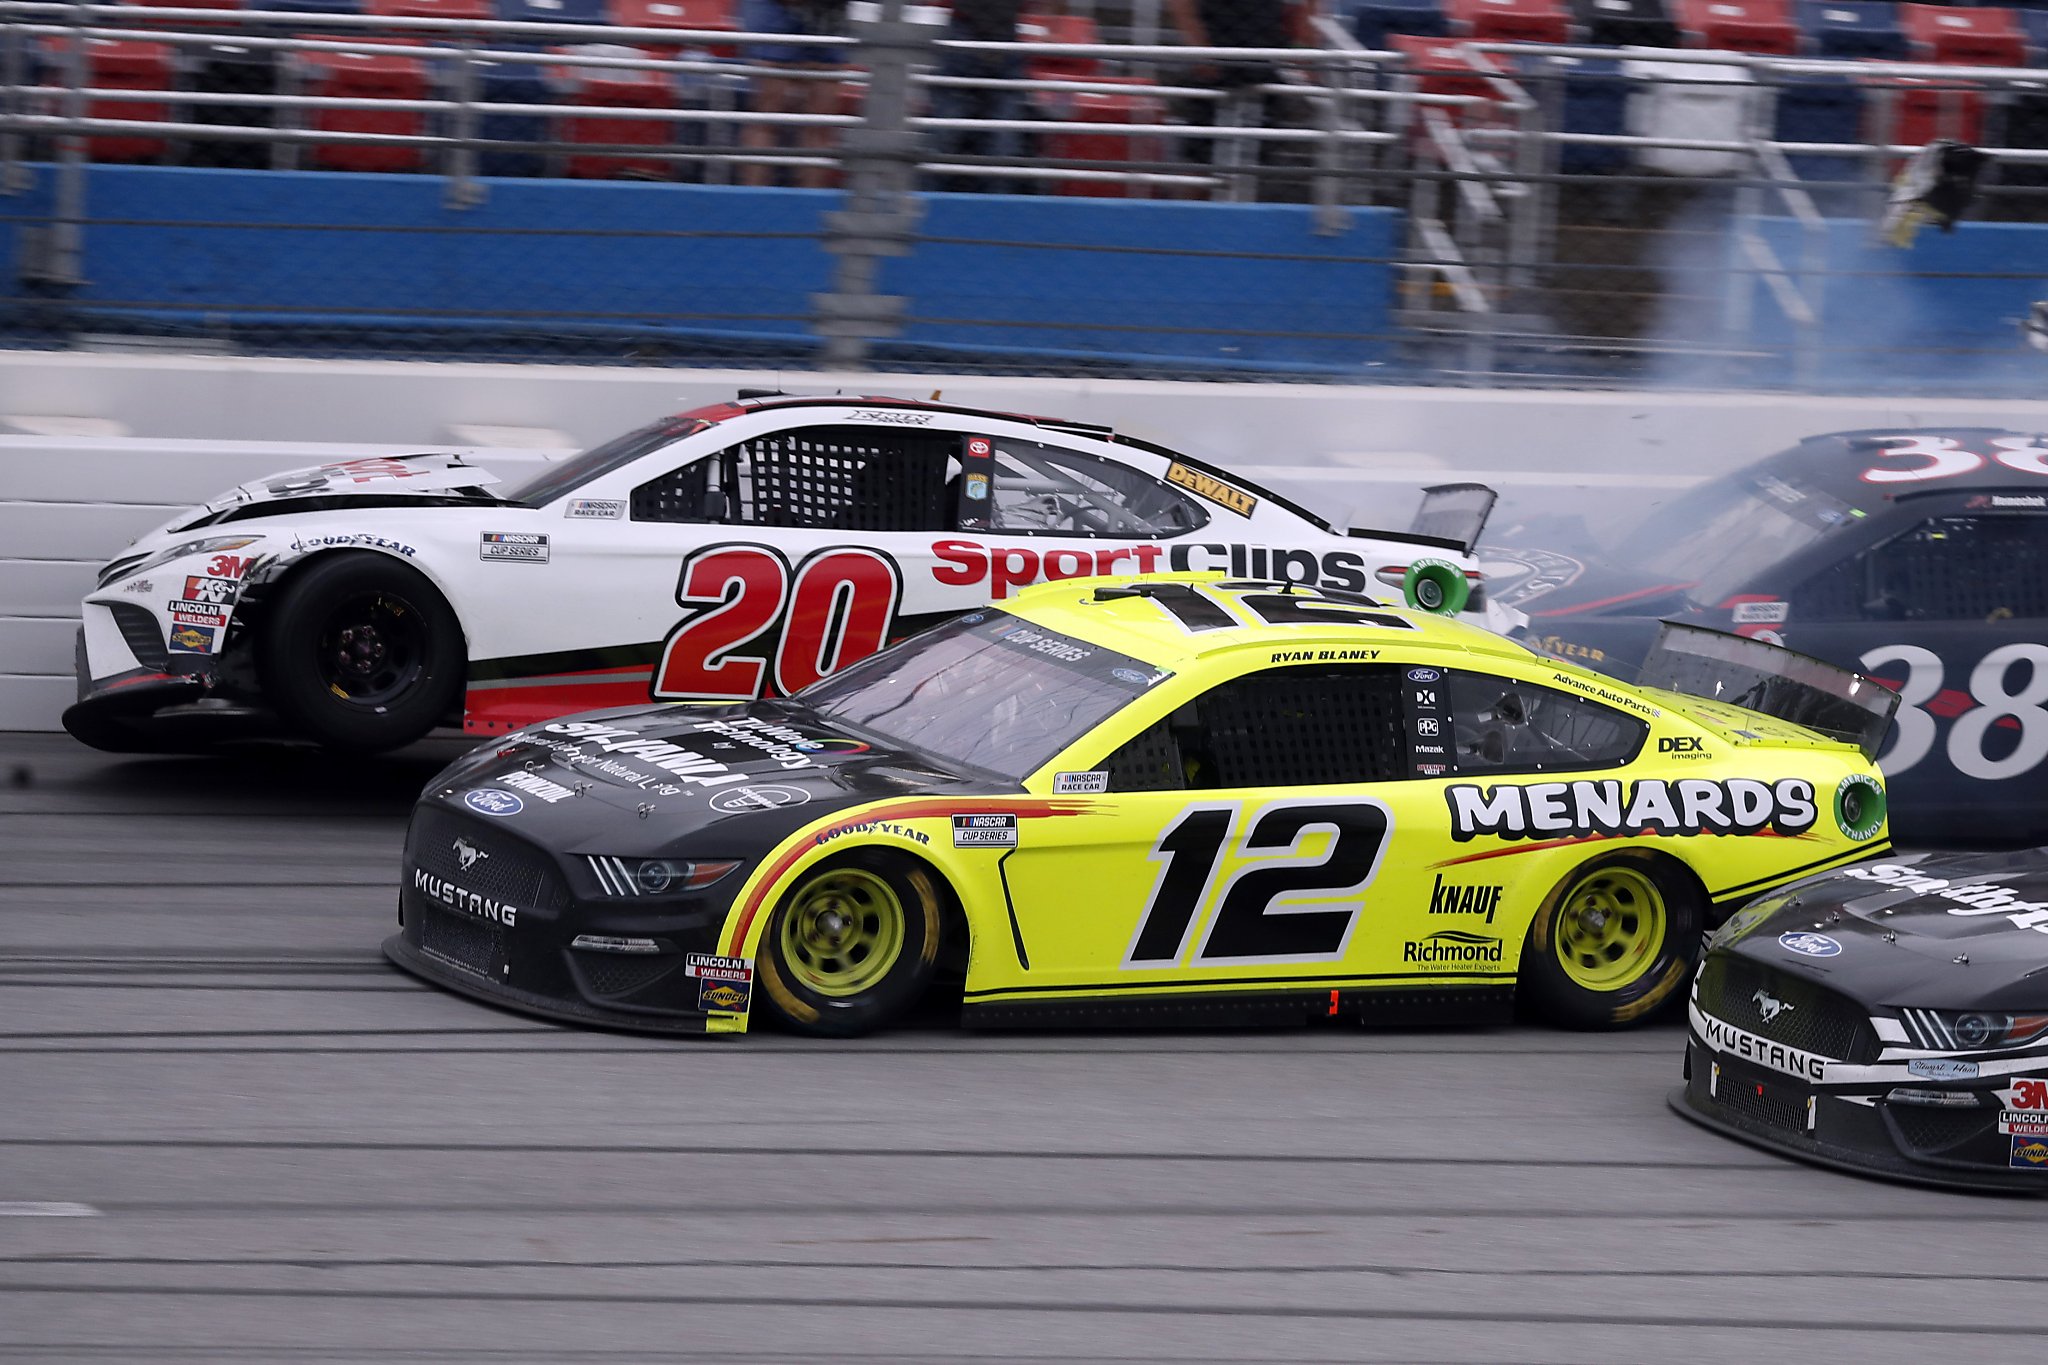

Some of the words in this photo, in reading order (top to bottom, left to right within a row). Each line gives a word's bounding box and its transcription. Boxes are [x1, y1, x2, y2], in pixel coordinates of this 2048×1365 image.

[490, 546, 508, 555] CUP
[509, 546, 540, 556] SERIES
[170, 602, 218, 615] LINCOLN
[178, 613, 220, 625] WELDERS
[652, 544, 902, 699] 20
[1005, 629, 1042, 645] CUP
[1029, 638, 1091, 662] SERIES
[1271, 652, 1313, 663] RYAN
[1318, 649, 1381, 661] BLANEY
[1411, 669, 1437, 681] Ford
[1553, 673, 1596, 694] Advance
[1597, 688, 1623, 703] Auto
[1624, 699, 1651, 715] Parts
[1419, 719, 1437, 735] PPG
[1415, 745, 1444, 754] Mazak
[1658, 737, 1703, 753] DEX
[1672, 752, 1712, 761] imaging
[1072, 774, 1101, 782] NASCAR
[1838, 774, 1883, 796] AMERICAN
[469, 790, 519, 813] Ford
[1447, 779, 1816, 841] MENARDS
[973, 817, 1007, 827] NASCAR
[815, 819, 930, 846] GOODYEAR
[962, 831, 979, 840] CUP
[979, 831, 1008, 840] SERIES
[1841, 821, 1883, 840] ETHANOL
[1121, 798, 1392, 968] 12
[415, 868, 517, 927] MUSTANG
[1404, 938, 1503, 961] Richmond
[1783, 933, 1838, 956] Ford
[690, 956, 742, 969] LINCOLN
[1451, 963, 1473, 971] Heater
[1474, 964, 1501, 972] Experts
[701, 968, 746, 979] WELDERS
[703, 990, 747, 1003] SUNOCO
[1705, 1018, 1827, 1080] MUSTANG
[1914, 1061, 1945, 1072] Stewart
[1953, 1064, 1976, 1073] Haas
[2013, 1125, 2048, 1133] WELDE
